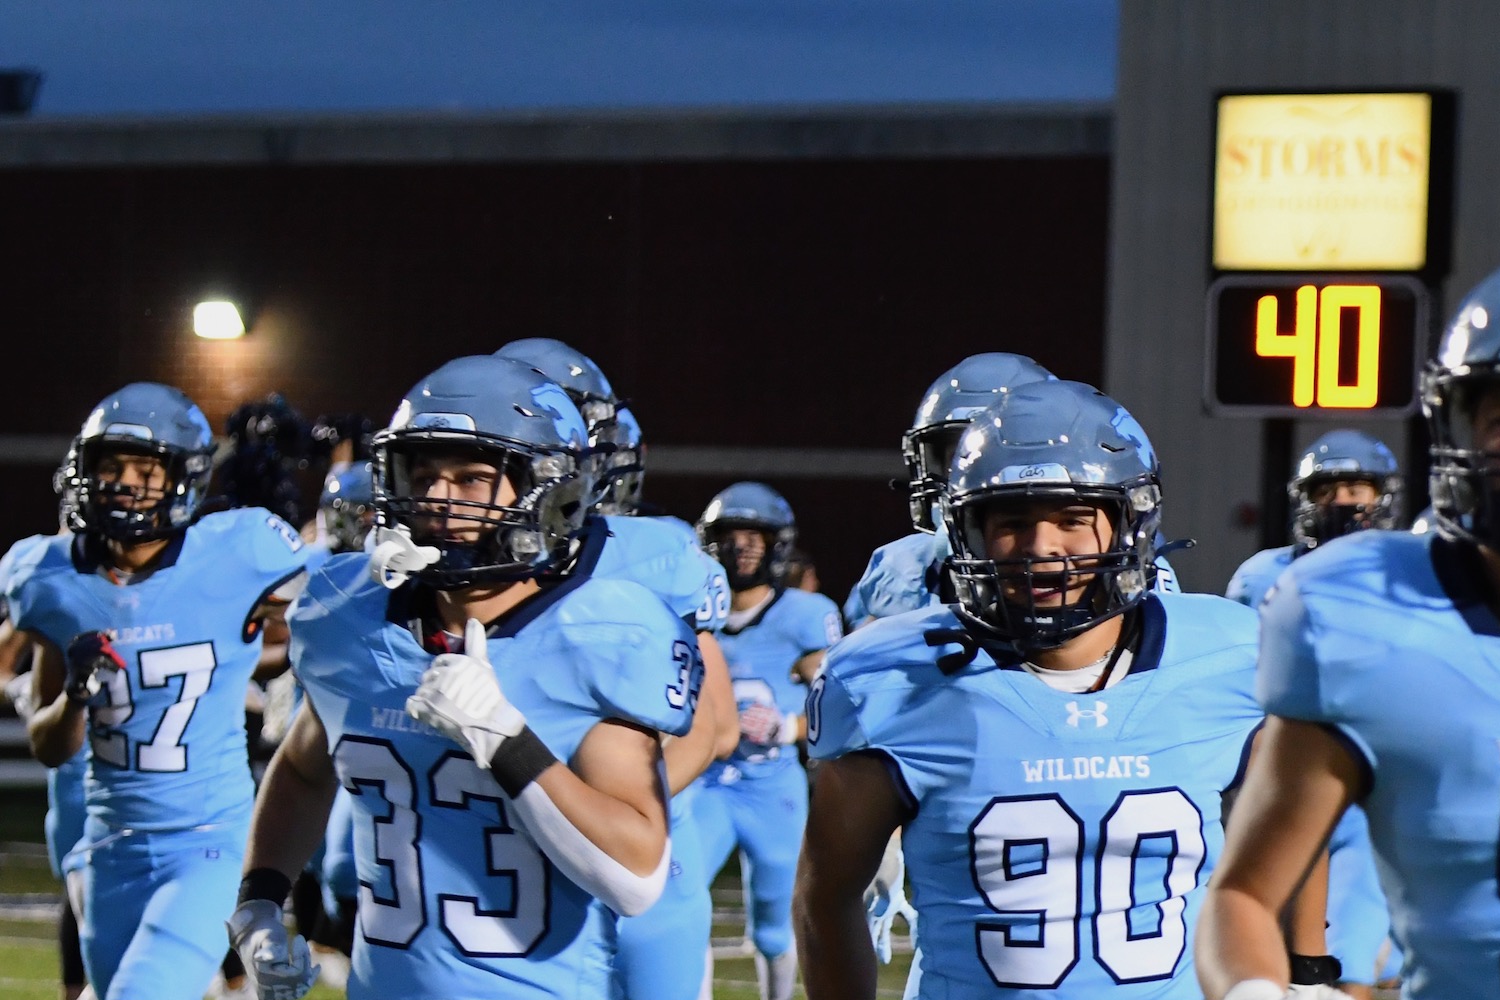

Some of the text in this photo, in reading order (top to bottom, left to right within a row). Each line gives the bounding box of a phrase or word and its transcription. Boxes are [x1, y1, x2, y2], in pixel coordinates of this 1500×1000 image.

[1224, 135, 1424, 178] STORMS
[1255, 284, 1383, 408] 40
[1018, 465, 1045, 479] Cats
[88, 639, 217, 773] 27
[1021, 756, 1151, 783] WILDCATS
[332, 733, 552, 959] 33
[967, 785, 1208, 990] 90
